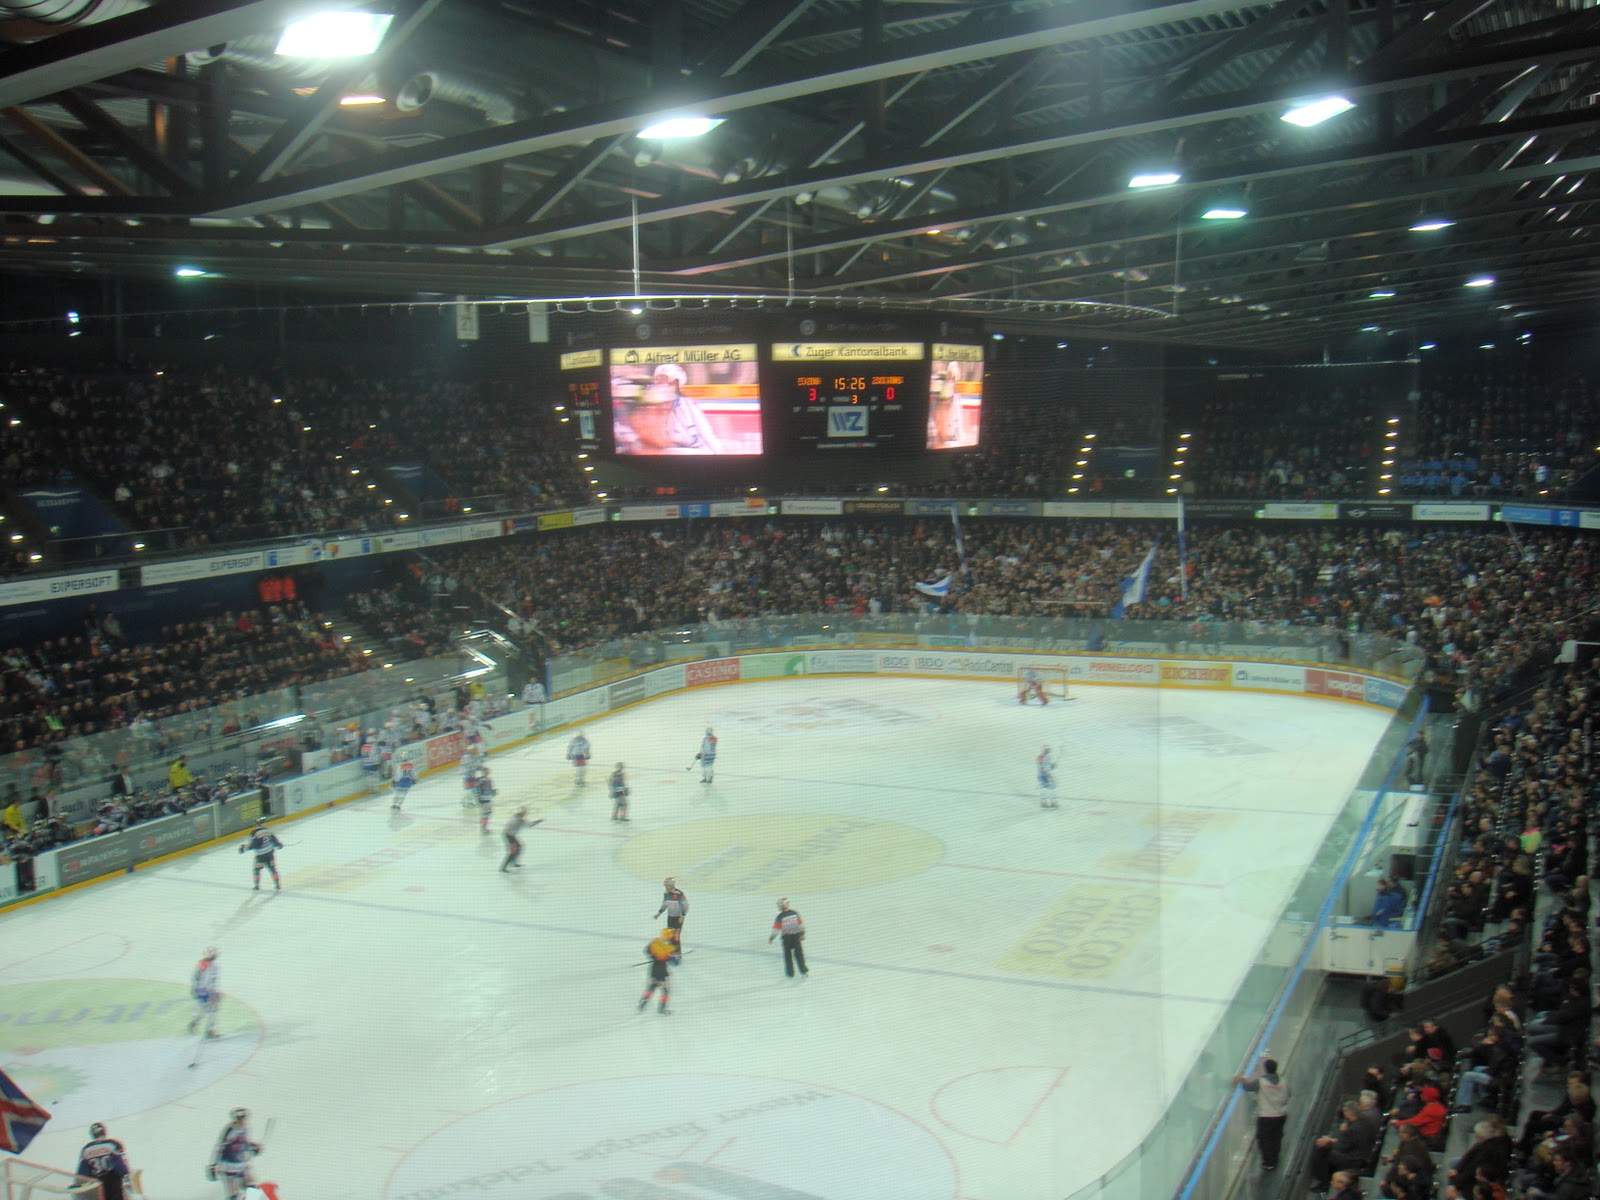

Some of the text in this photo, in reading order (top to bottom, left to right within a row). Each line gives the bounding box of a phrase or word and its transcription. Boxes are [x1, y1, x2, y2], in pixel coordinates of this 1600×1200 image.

[645, 349, 741, 364] Alfred Müller AG
[806, 345, 907, 360] Zuger Kantonalbank
[834, 377, 866, 390] 15:26
[809, 388, 817, 401] 3
[852, 394, 858, 404] 3
[886, 387, 895, 400] 0
[50, 575, 112, 593] EXPERSOFT
[688, 664, 737, 681] CASINO
